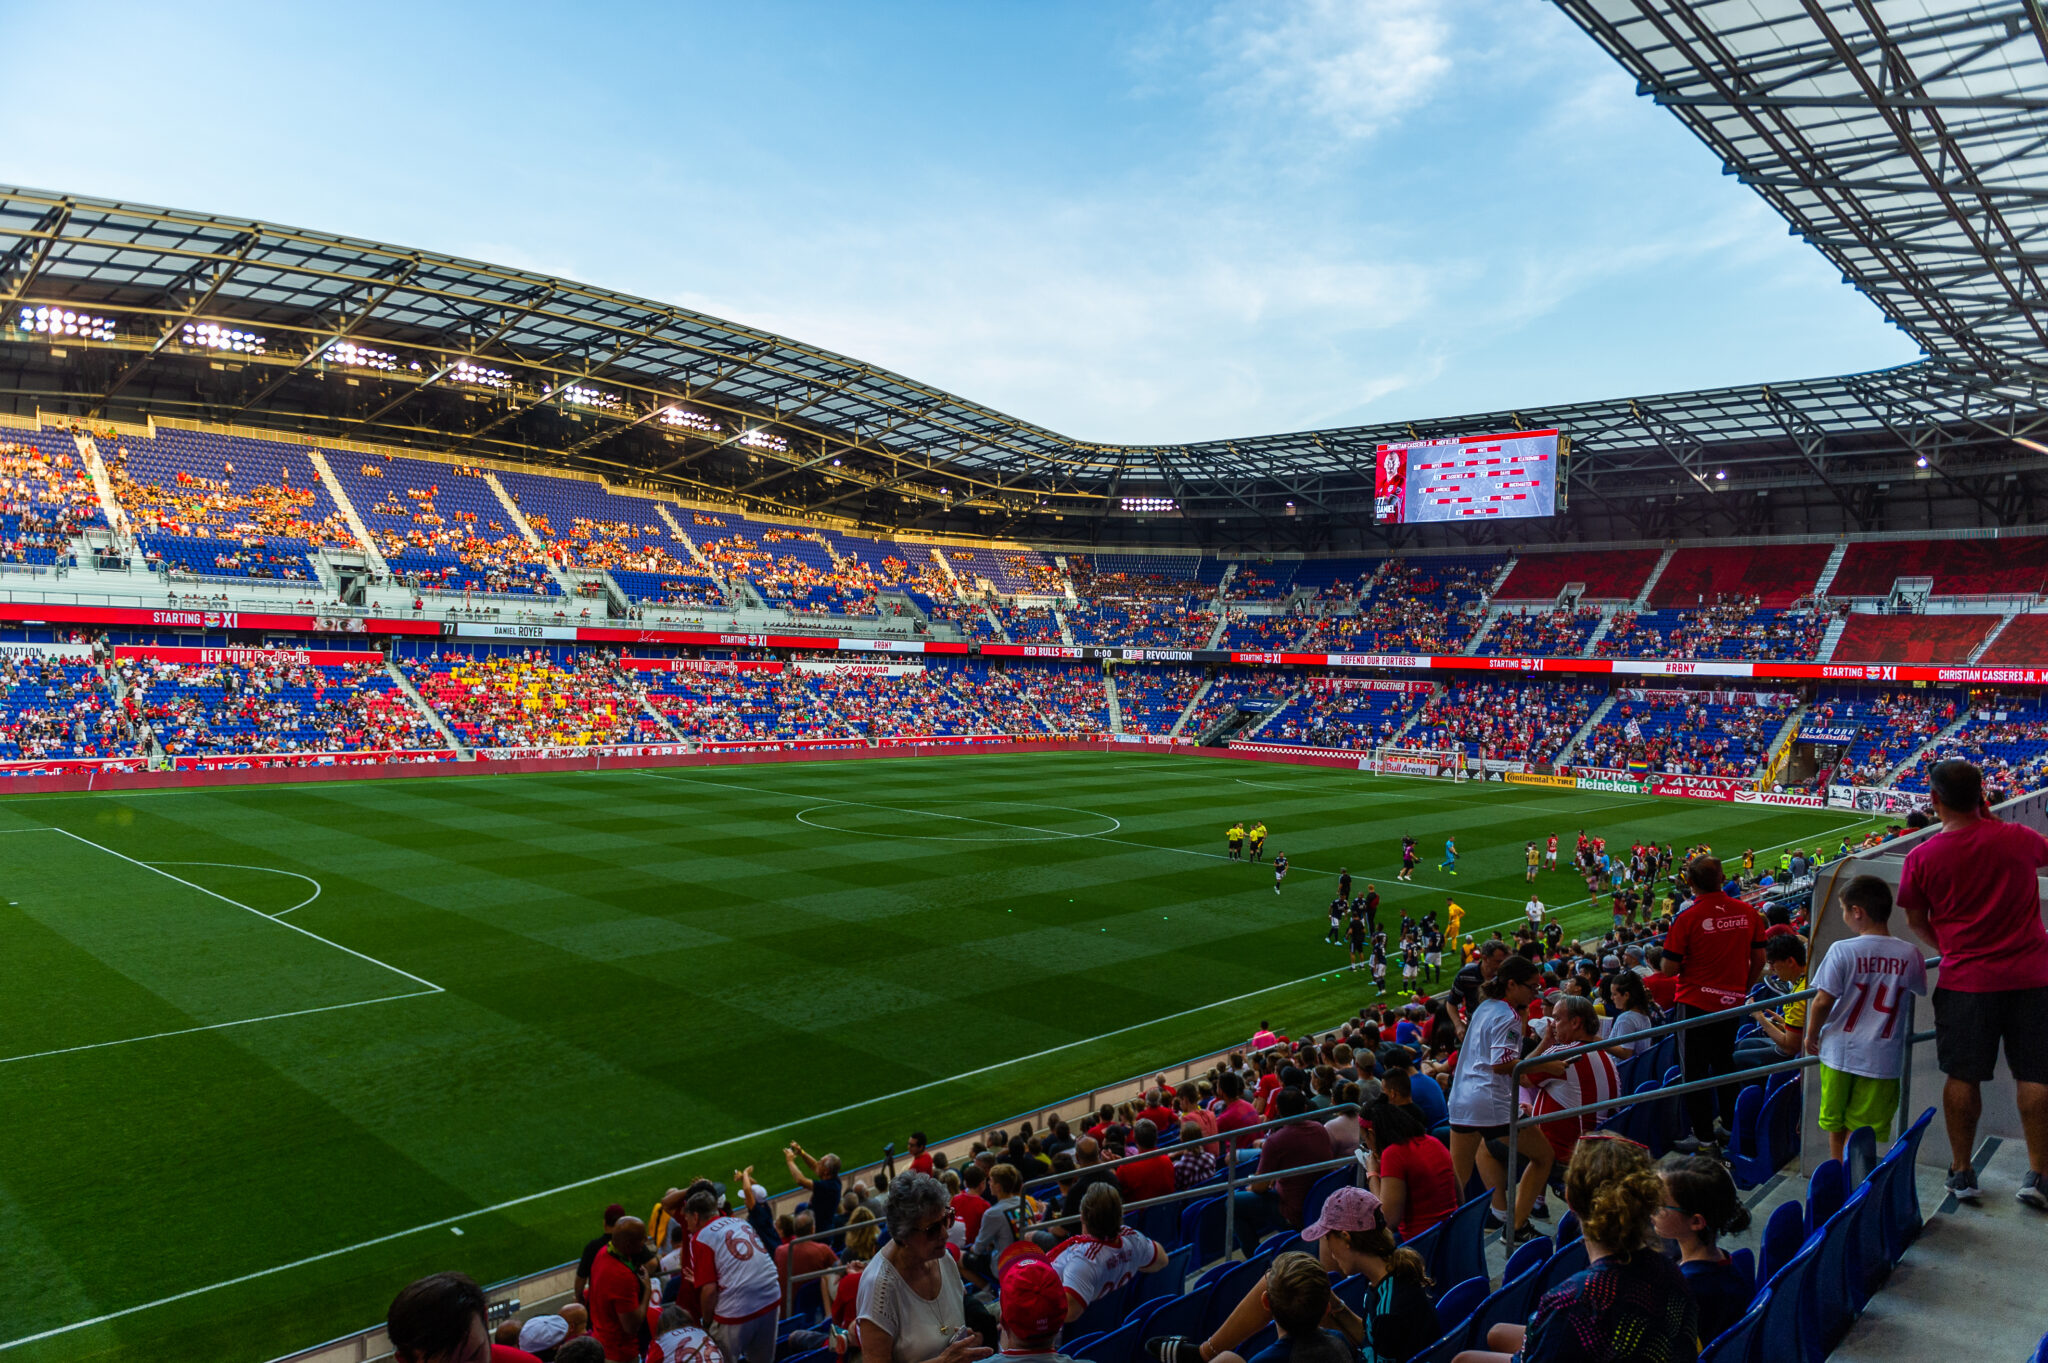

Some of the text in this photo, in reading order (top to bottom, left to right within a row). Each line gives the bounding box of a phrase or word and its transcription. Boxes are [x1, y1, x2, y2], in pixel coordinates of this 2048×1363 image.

[153, 612, 238, 628] STARTING XI
[444, 623, 455, 634] 77
[494, 626, 543, 637] DANIEL ROYER
[720, 635, 767, 647] STARTING XI
[873, 640, 892, 649] #RBNY
[201, 649, 222, 662] NEW
[1024, 646, 1059, 657] RED BULLS
[1076, 649, 1081, 657] 0
[1094, 649, 1112, 658] 0:00
[1125, 650, 1130, 658] 0
[1146, 650, 1192, 660] REVOLUTION
[1240, 653, 1281, 664] STARTING XI
[1340, 655, 1416, 666] DEFEND OUR FORTRESS
[851, 665, 889, 674] YANMAR
[1489, 658, 1543, 671] STARTING XI
[1665, 663, 1695, 673] #RBNY
[1823, 666, 1896, 680] STARTING XI
[1938, 669, 1980, 680] CHRISTIAN
[1982, 670, 2023, 680] CASSERES
[1373, 681, 1406, 690] TOGETHER
[1386, 762, 1402, 772] Bull
[1402, 764, 1426, 775] Arena
[1507, 773, 1574, 786] Continental TIRE
[1669, 776, 1736, 790] ARMY
[1576, 777, 1637, 794] Heineken
[1659, 787, 1682, 795] Audi
[1760, 794, 1823, 807] YANMAR
[1858, 957, 1909, 975] HENRY
[1844, 982, 1905, 1039] 14
